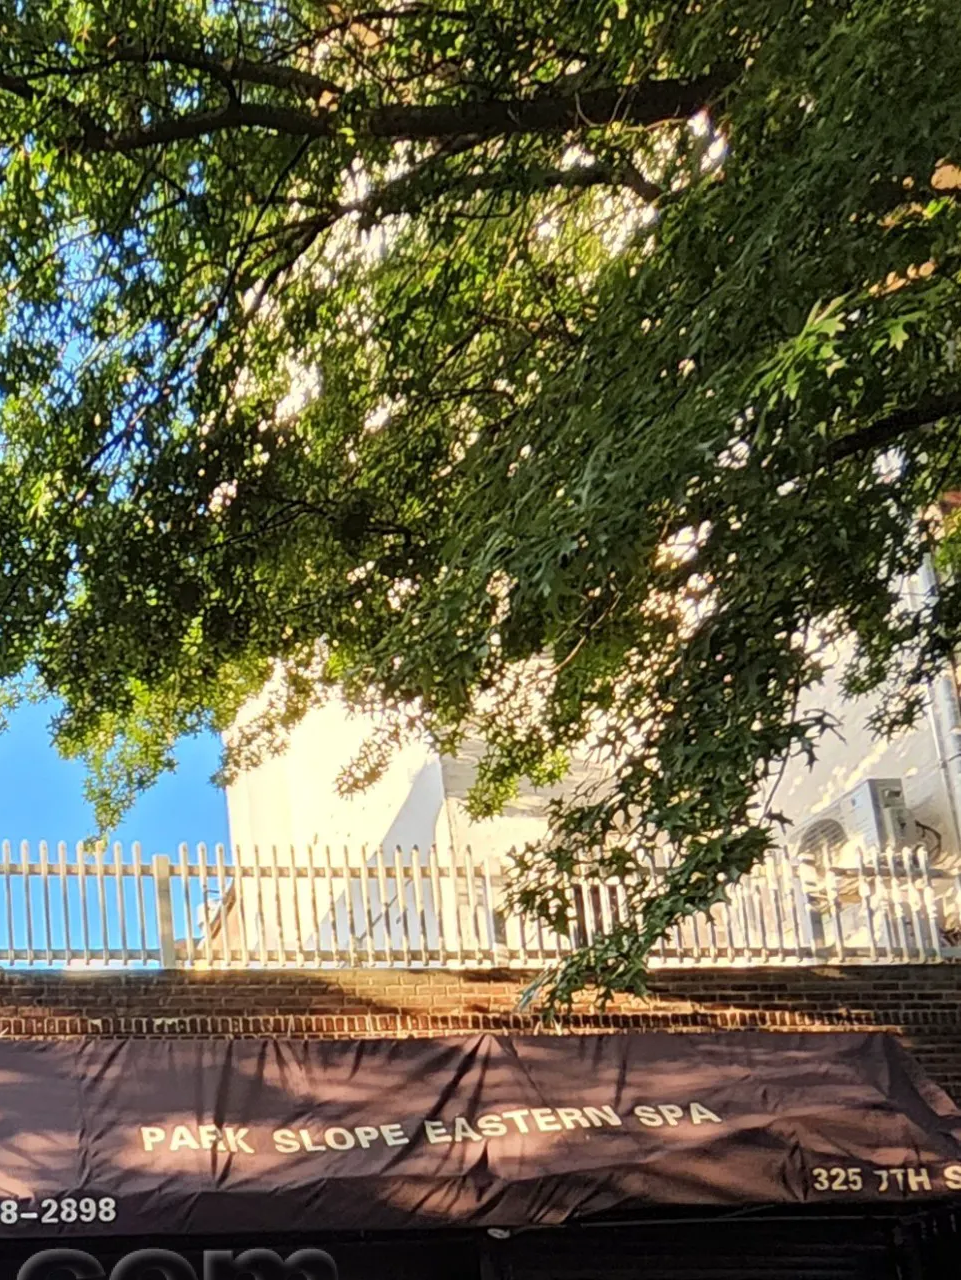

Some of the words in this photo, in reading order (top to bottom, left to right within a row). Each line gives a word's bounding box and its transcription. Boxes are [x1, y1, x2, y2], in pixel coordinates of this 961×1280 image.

[140, 1124, 255, 1154] PARK
[272, 1123, 410, 1153] SLOPE
[424, 1104, 623, 1144] EASTERN
[633, 1102, 722, 1127] SPA
[812, 1167, 864, 1192] 325
[873, 1168, 932, 1192] 7TH
